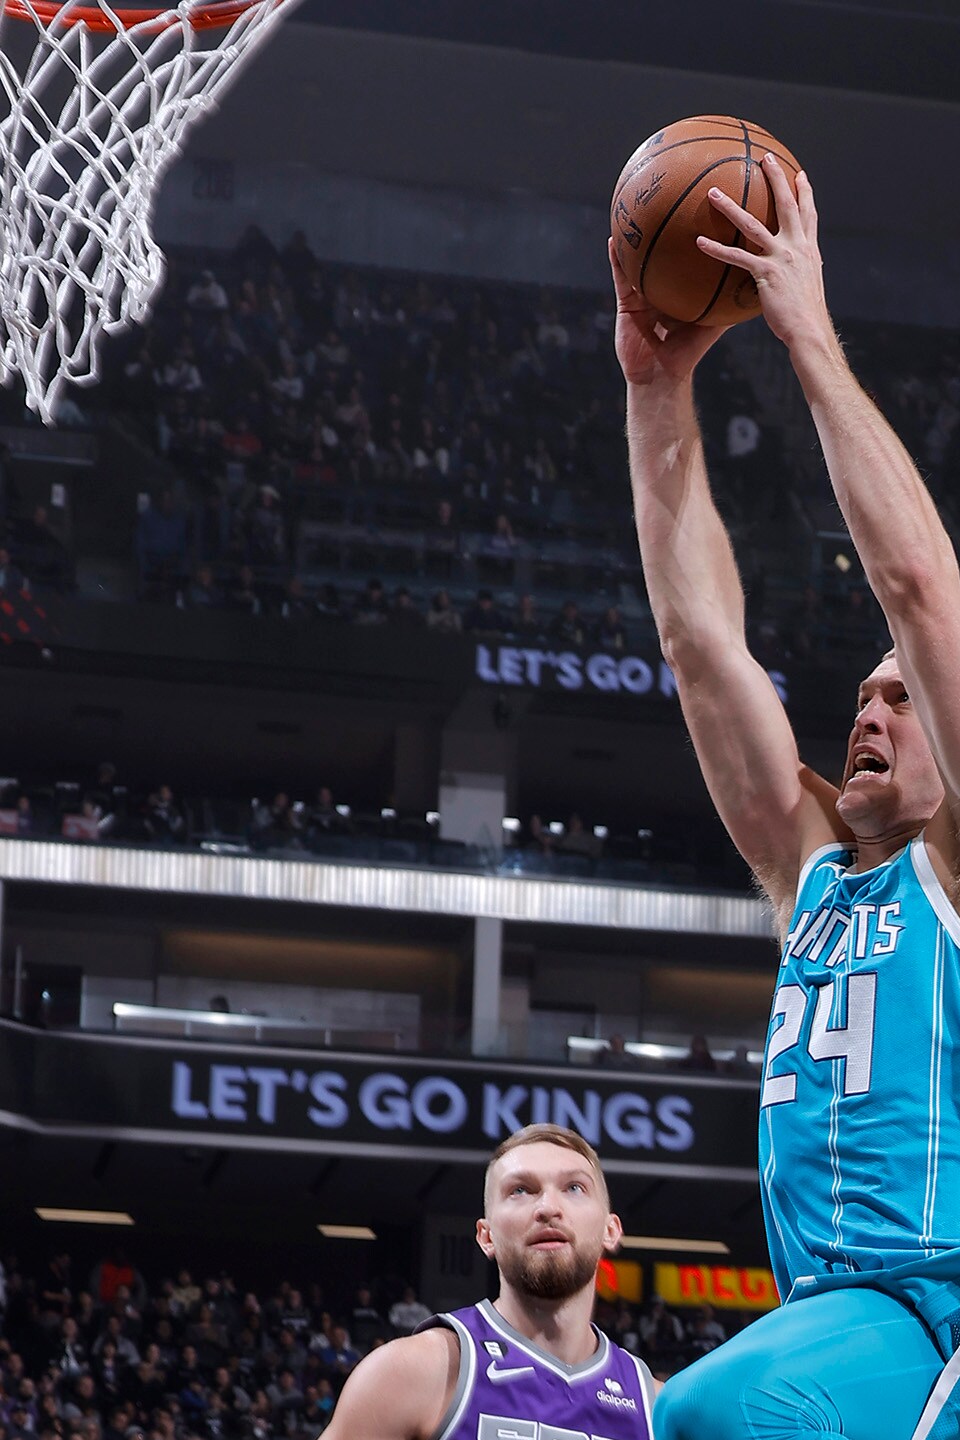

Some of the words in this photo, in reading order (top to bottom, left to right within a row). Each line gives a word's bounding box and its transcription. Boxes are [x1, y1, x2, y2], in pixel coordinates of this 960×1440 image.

[476, 645, 585, 691] LET'S
[587, 654, 657, 695] GO
[761, 971, 878, 1109] 24
[171, 1061, 350, 1131] LET'S
[358, 1072, 470, 1134] GO
[482, 1081, 694, 1152] KINGS
[596, 1389, 637, 1410] dialpad
